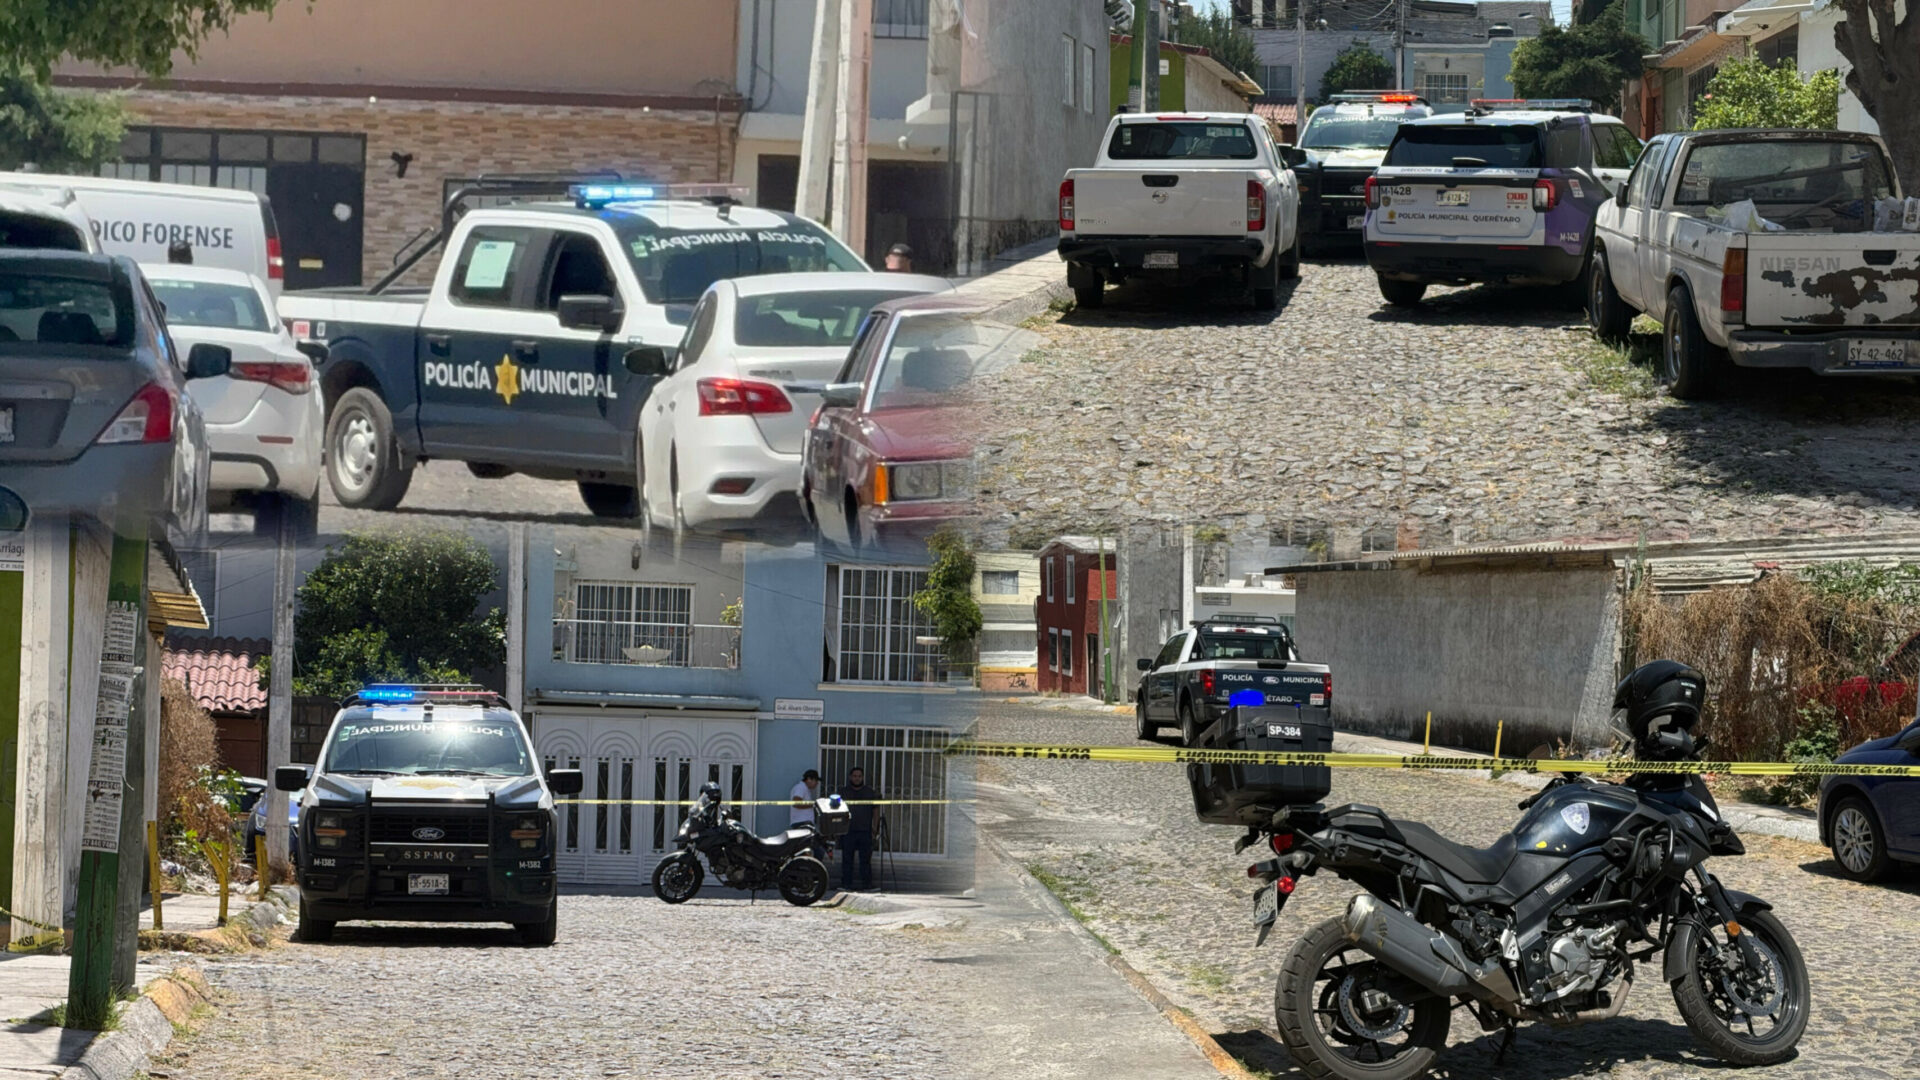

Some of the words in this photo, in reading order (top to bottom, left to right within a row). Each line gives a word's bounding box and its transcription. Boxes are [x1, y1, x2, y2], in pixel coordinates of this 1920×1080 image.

[1380, 186, 1412, 196] M-1428
[1429, 213, 1468, 221] MUNICIPAL
[1472, 214, 1521, 223] QUERÉTARO
[90, 219, 136, 243] DICO
[142, 222, 234, 249] FORENSE
[1759, 256, 1841, 272] NISSAN
[1849, 347, 1904, 361] SY-42-462
[424, 360, 492, 390] POLICÍA
[520, 367, 618, 399] MUNICIPAL
[1222, 673, 1254, 682] POLICÍA
[1282, 676, 1324, 684] MUNICIPAL
[1266, 694, 1293, 703] ÉTARO
[1269, 725, 1301, 737] SP-384
[416, 828, 443, 840] Ford
[313, 857, 336, 867] M-1382
[518, 860, 542, 870] M-1382
